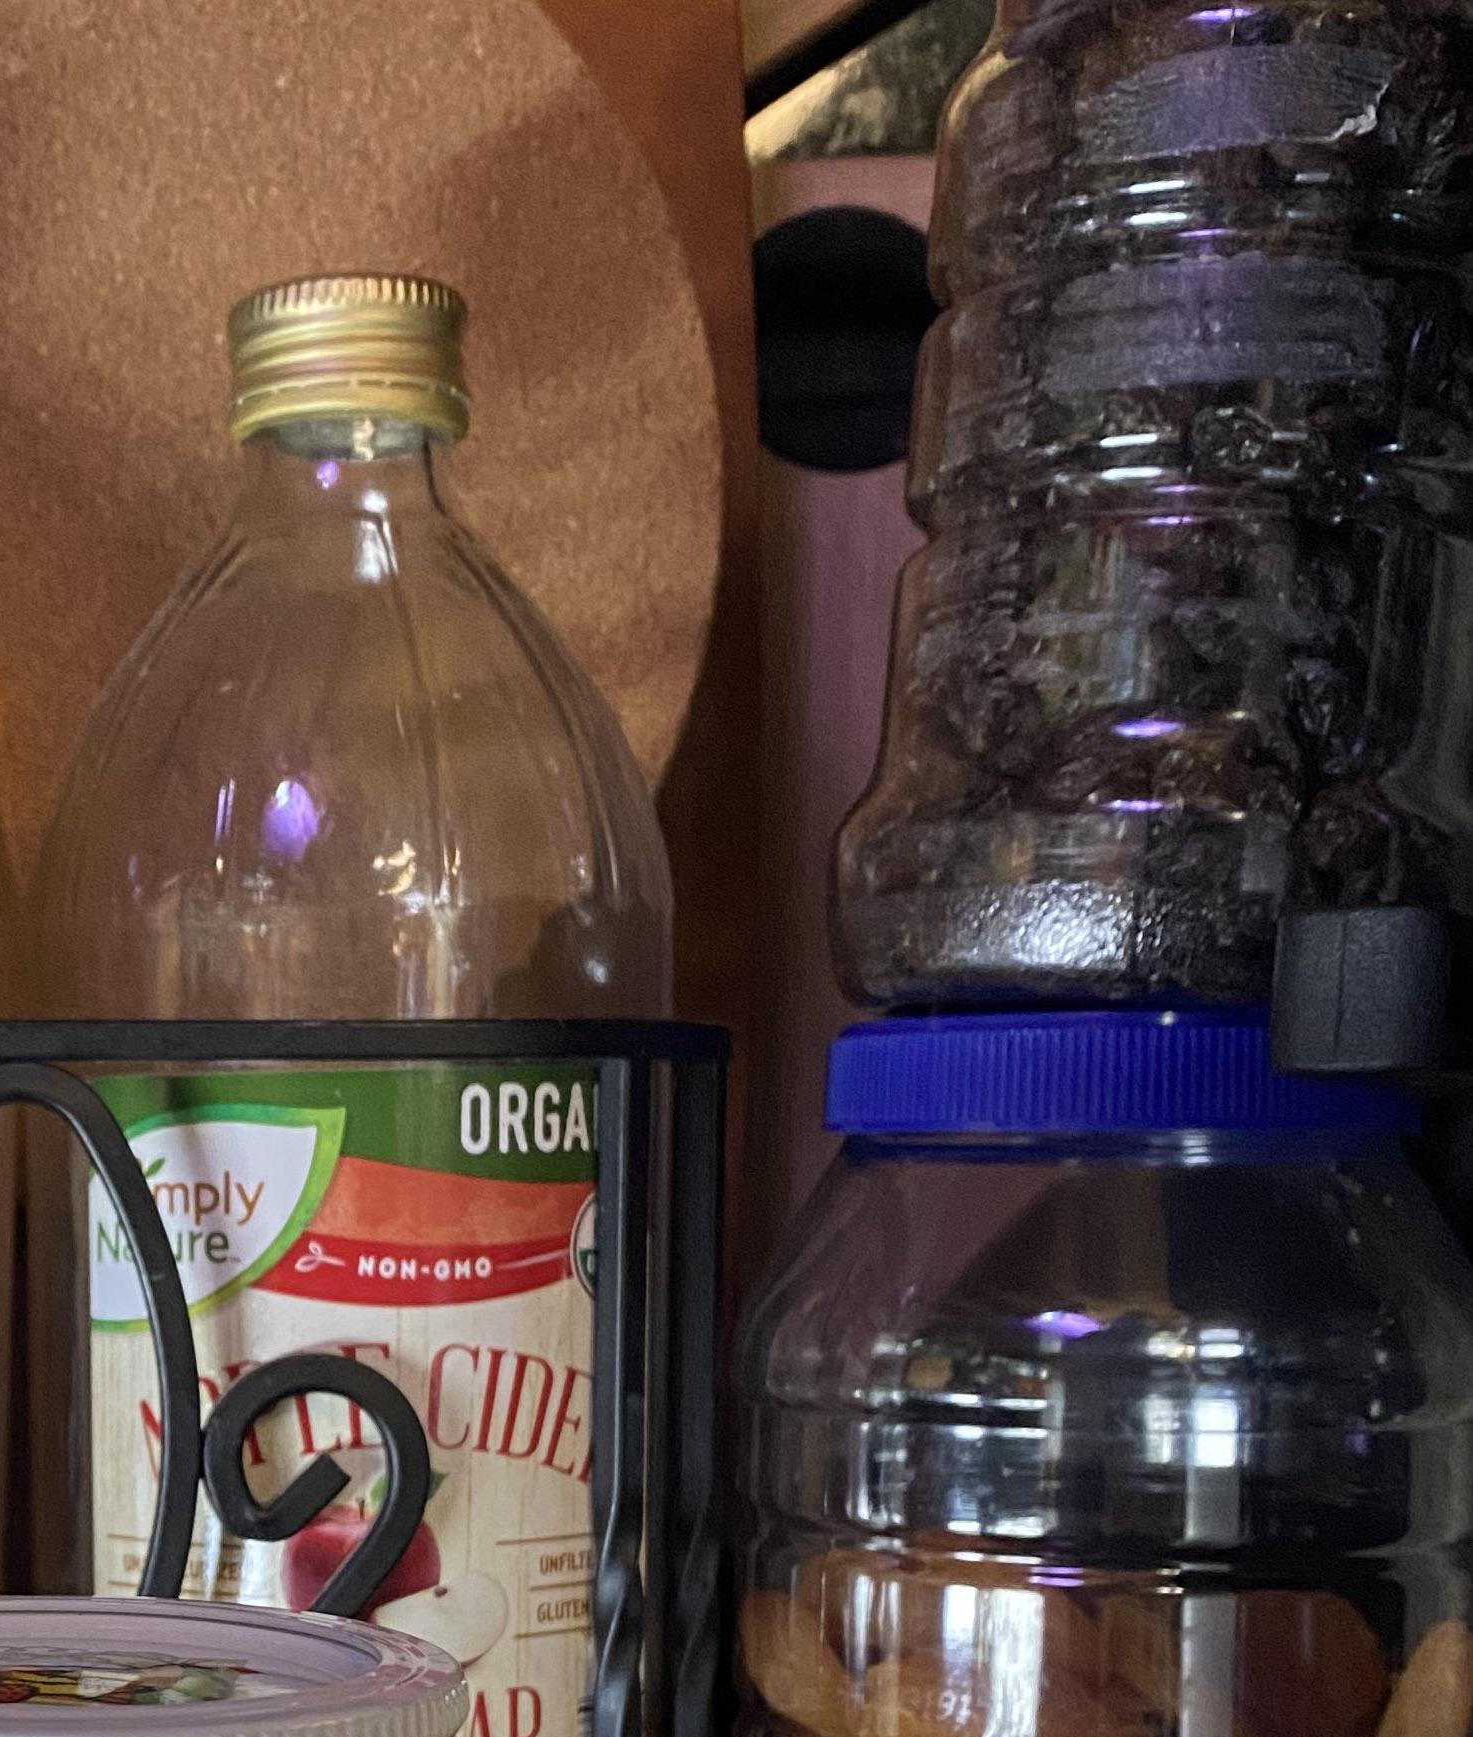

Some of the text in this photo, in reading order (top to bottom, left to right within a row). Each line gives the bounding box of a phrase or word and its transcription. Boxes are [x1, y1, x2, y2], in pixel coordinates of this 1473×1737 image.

[152, 1168, 266, 1227] mply
[357, 1254, 493, 1282] NON-GMO
[428, 1342, 595, 1486] CIDE
